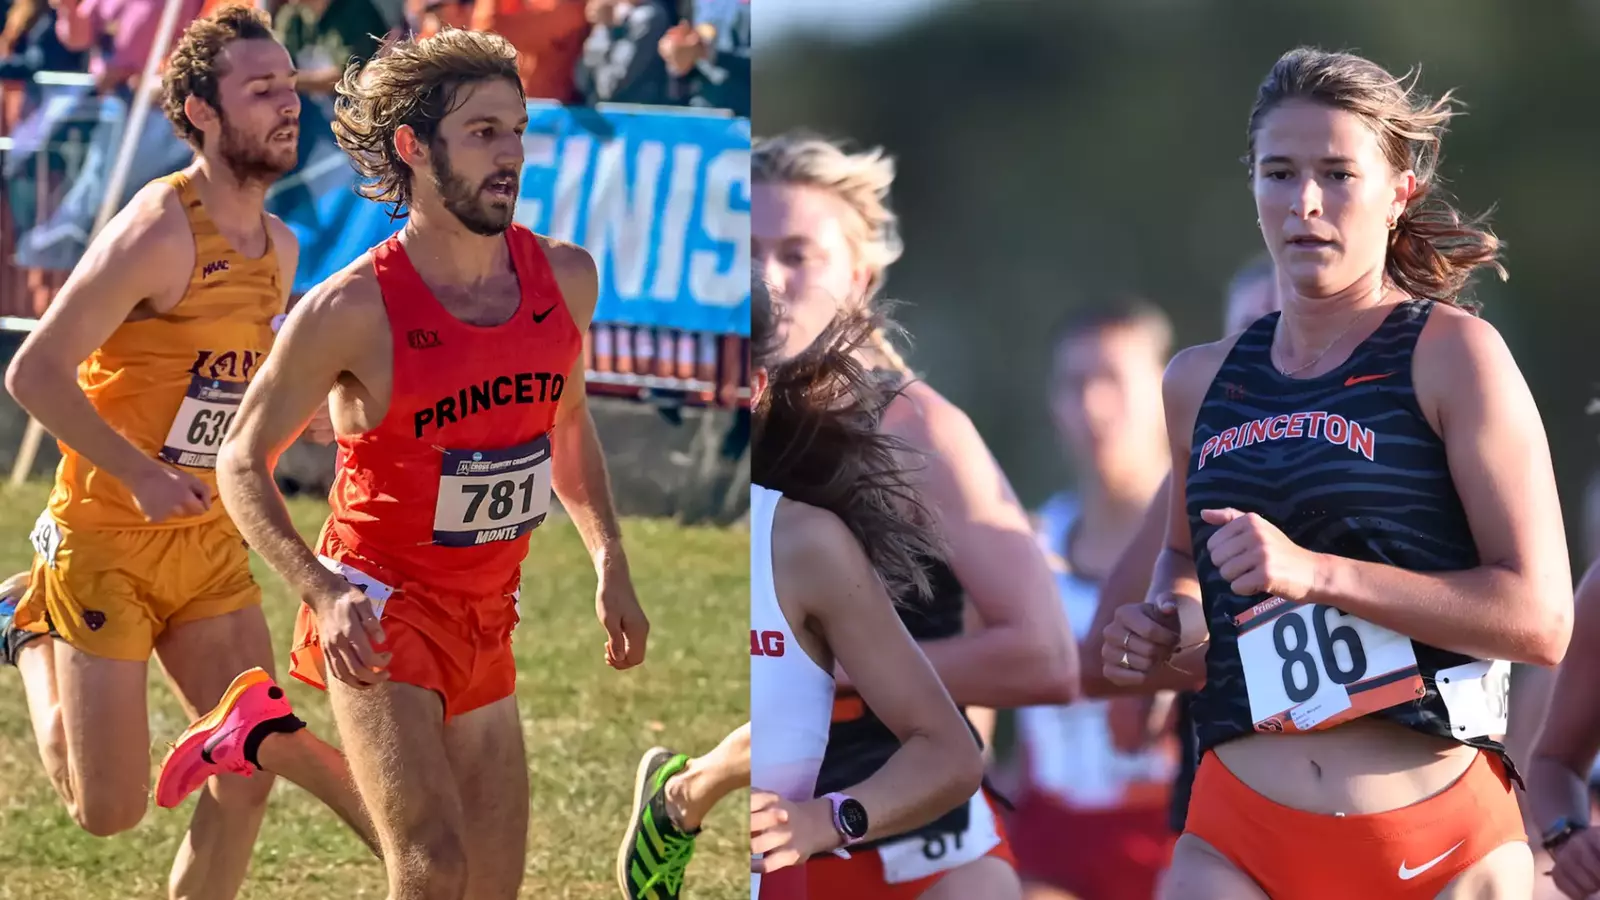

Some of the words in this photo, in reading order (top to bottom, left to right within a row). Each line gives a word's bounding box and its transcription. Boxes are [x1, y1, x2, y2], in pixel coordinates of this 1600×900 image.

[203, 260, 230, 280] MAAC
[414, 372, 567, 439] PRINCETO
[1197, 411, 1375, 471] PRINCETON
[462, 473, 535, 523] 781
[474, 526, 519, 544] MONTE
[1273, 604, 1367, 703] 86
